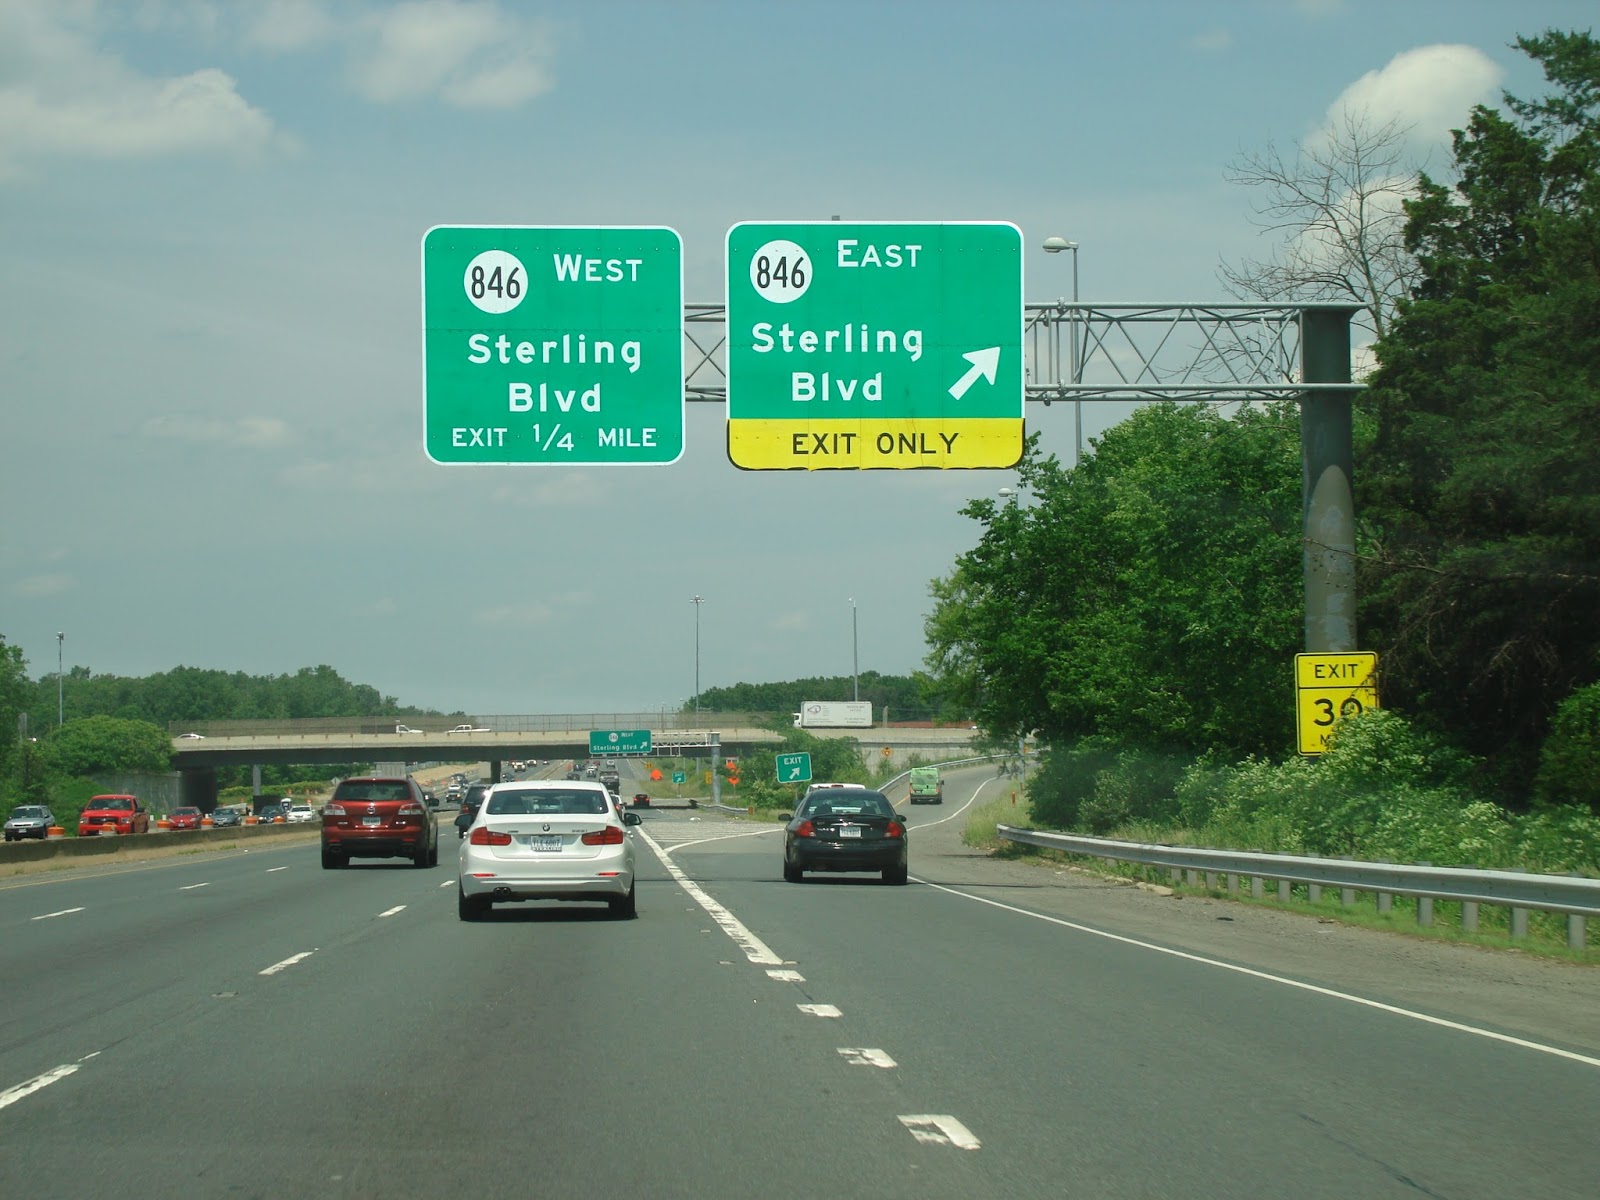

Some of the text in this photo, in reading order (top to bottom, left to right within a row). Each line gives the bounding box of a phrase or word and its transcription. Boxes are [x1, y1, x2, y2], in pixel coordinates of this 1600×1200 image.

[471, 253, 643, 299] 846 WEST
[756, 239, 922, 288] 846 EAST
[467, 333, 641, 374] Sterling
[751, 322, 923, 362] Sterling
[508, 382, 601, 413] Blvd
[791, 371, 883, 401] Blvd
[452, 423, 657, 451] EXIT 1/4 MILE
[792, 432, 960, 455] EXIT ONLY
[1314, 663, 1358, 679] EXIT
[783, 756, 803, 765] EXIT
